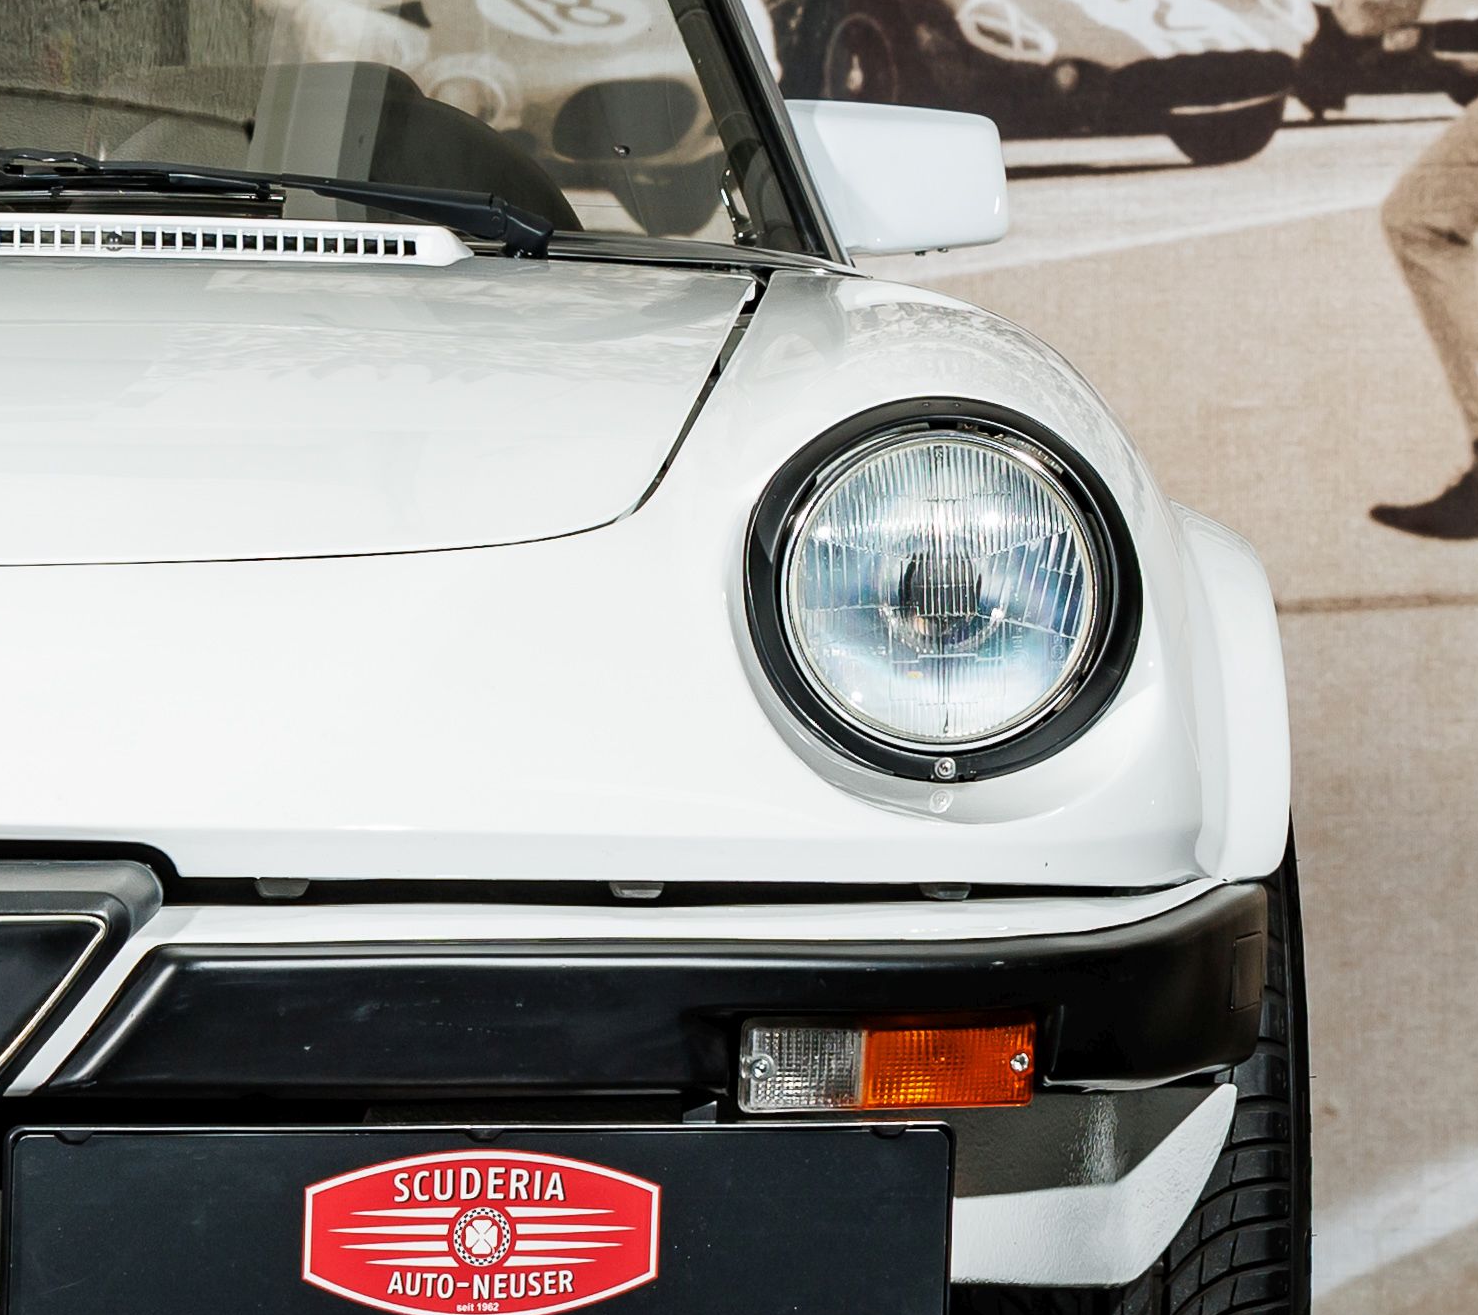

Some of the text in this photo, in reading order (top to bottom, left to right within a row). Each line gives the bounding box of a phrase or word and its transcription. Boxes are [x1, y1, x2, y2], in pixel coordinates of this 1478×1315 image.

[393, 1166, 567, 1204] SCUDERIA
[387, 1269, 575, 1301] AUTO-NEUSER
[456, 1302, 500, 1313] seit 1962
